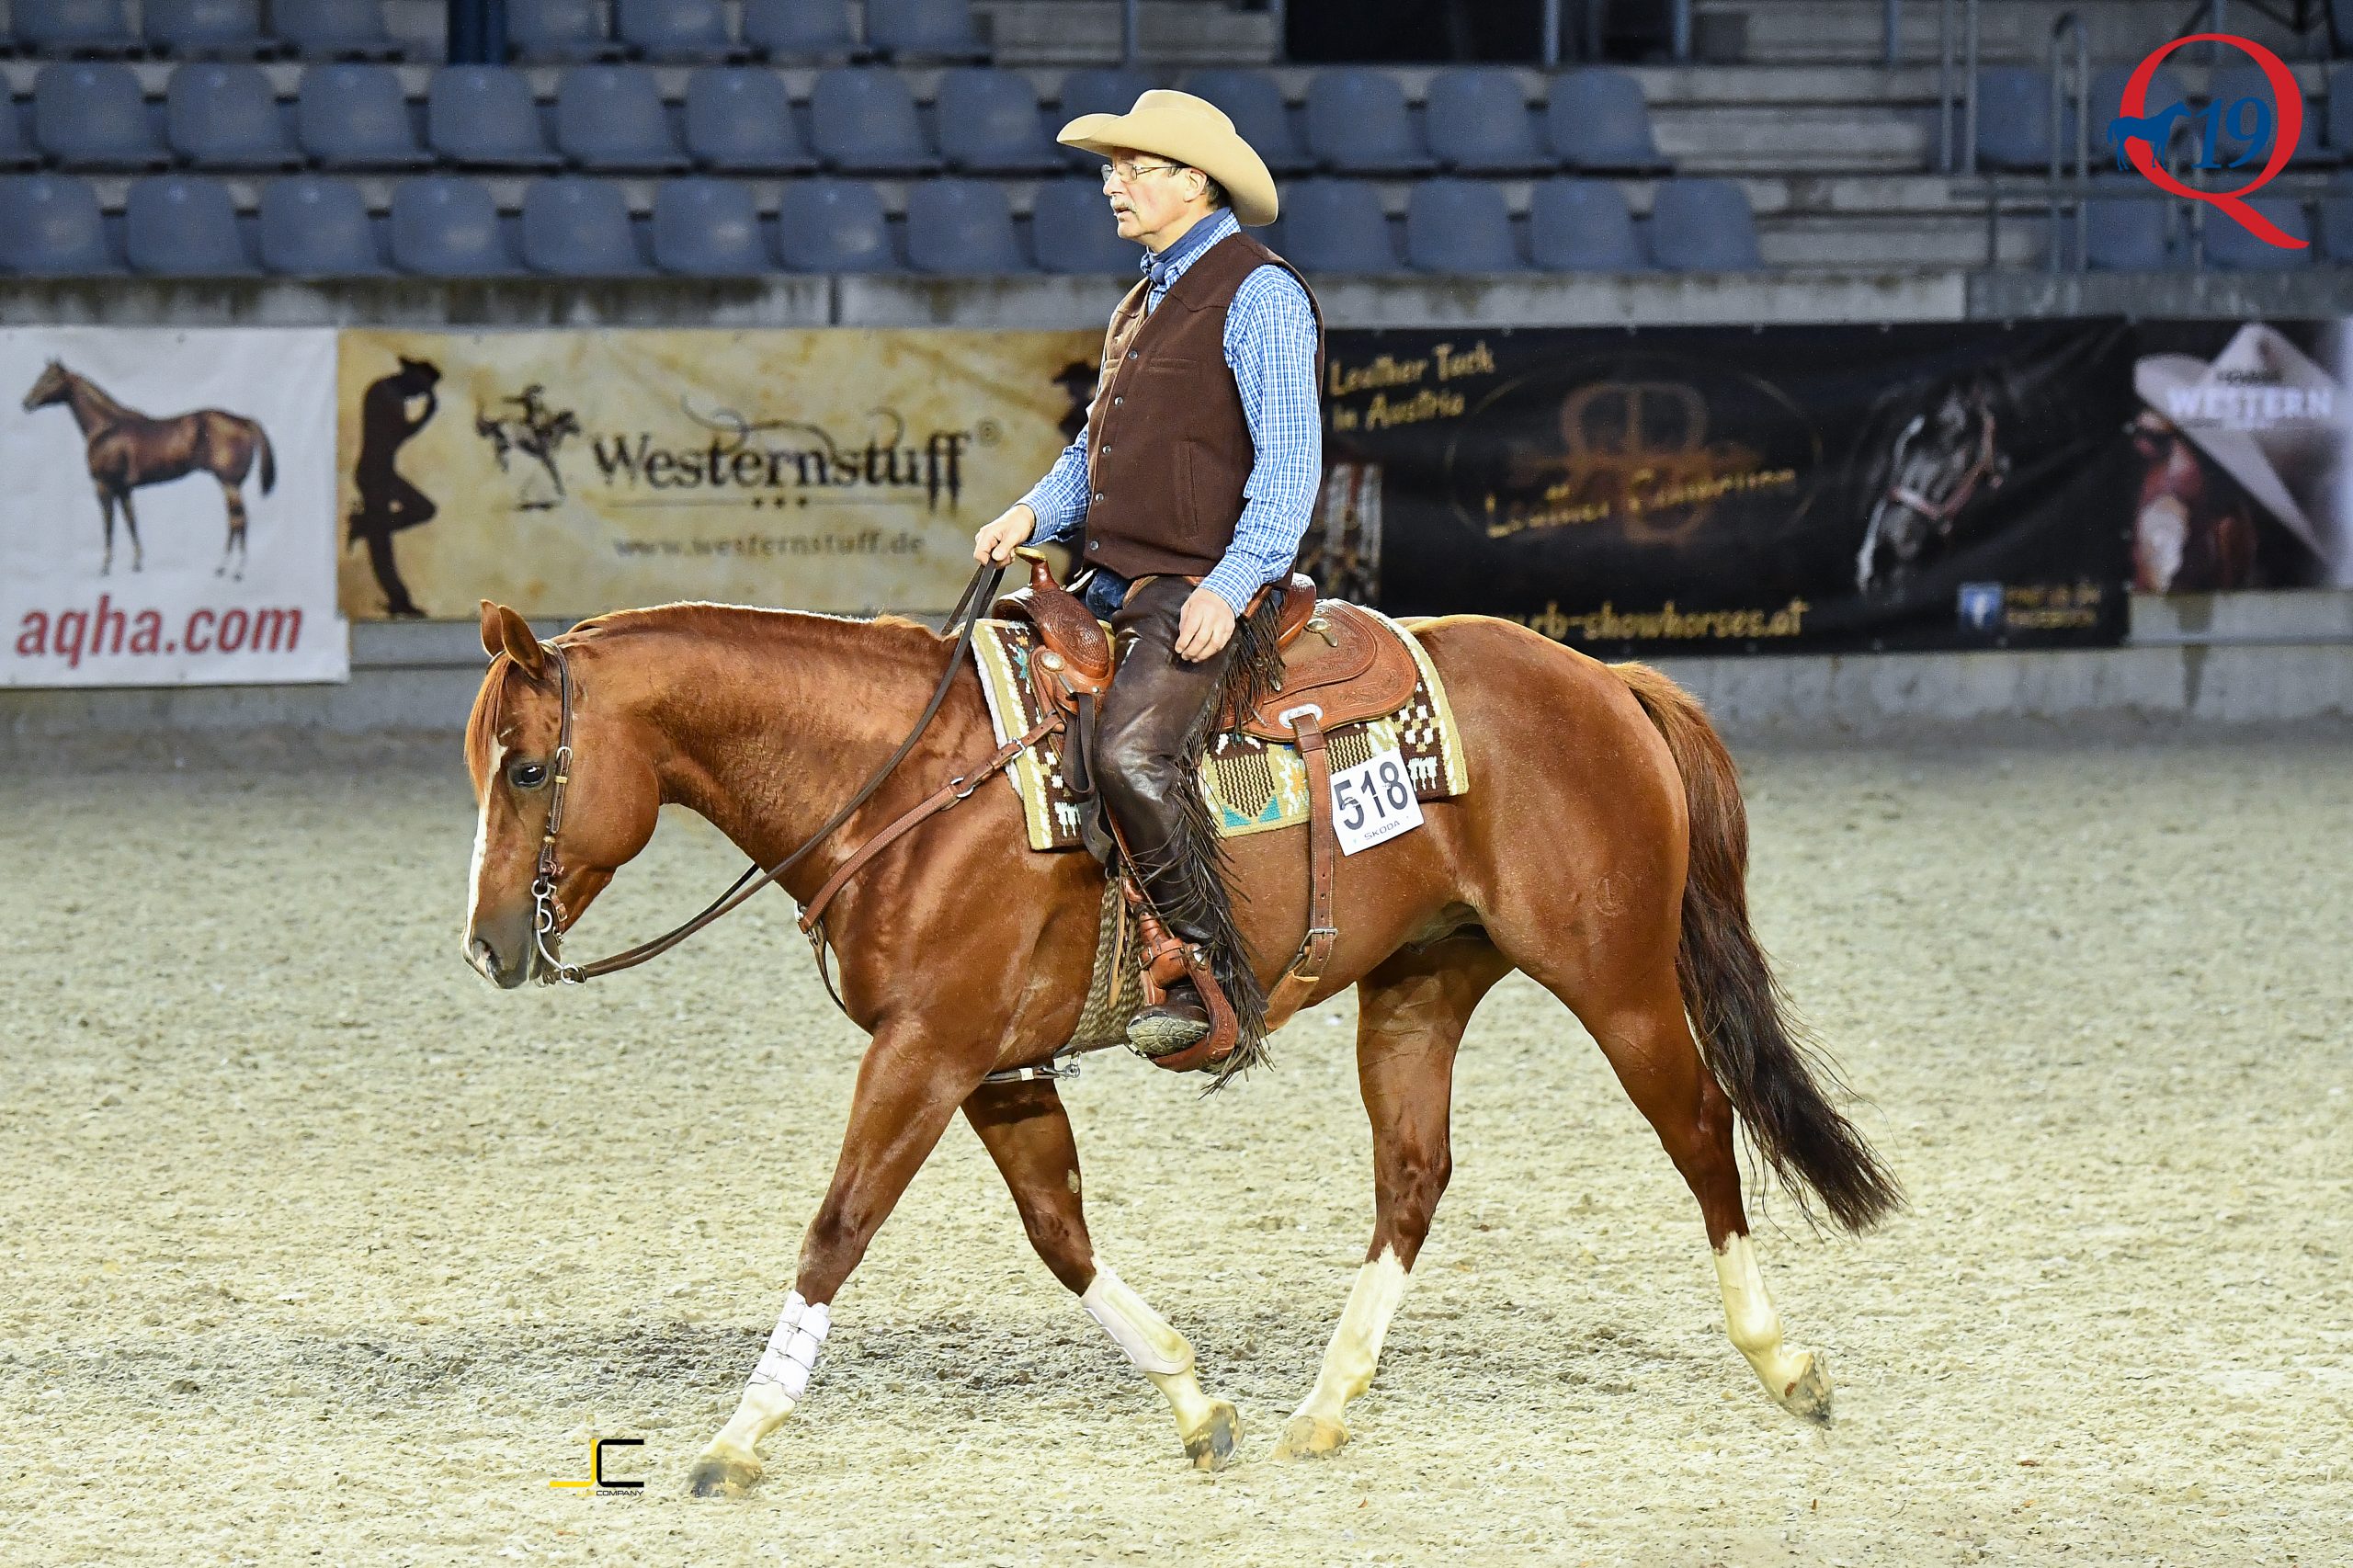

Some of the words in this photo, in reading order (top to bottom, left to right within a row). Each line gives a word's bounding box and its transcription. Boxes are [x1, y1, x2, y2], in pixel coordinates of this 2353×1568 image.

[1365, 390, 1465, 431] Austria
[591, 429, 971, 513] Westernstuff
[16, 595, 302, 669] aqha.com
[1505, 598, 1811, 642] rb-showhorses.at
[1334, 761, 1408, 831] 518
